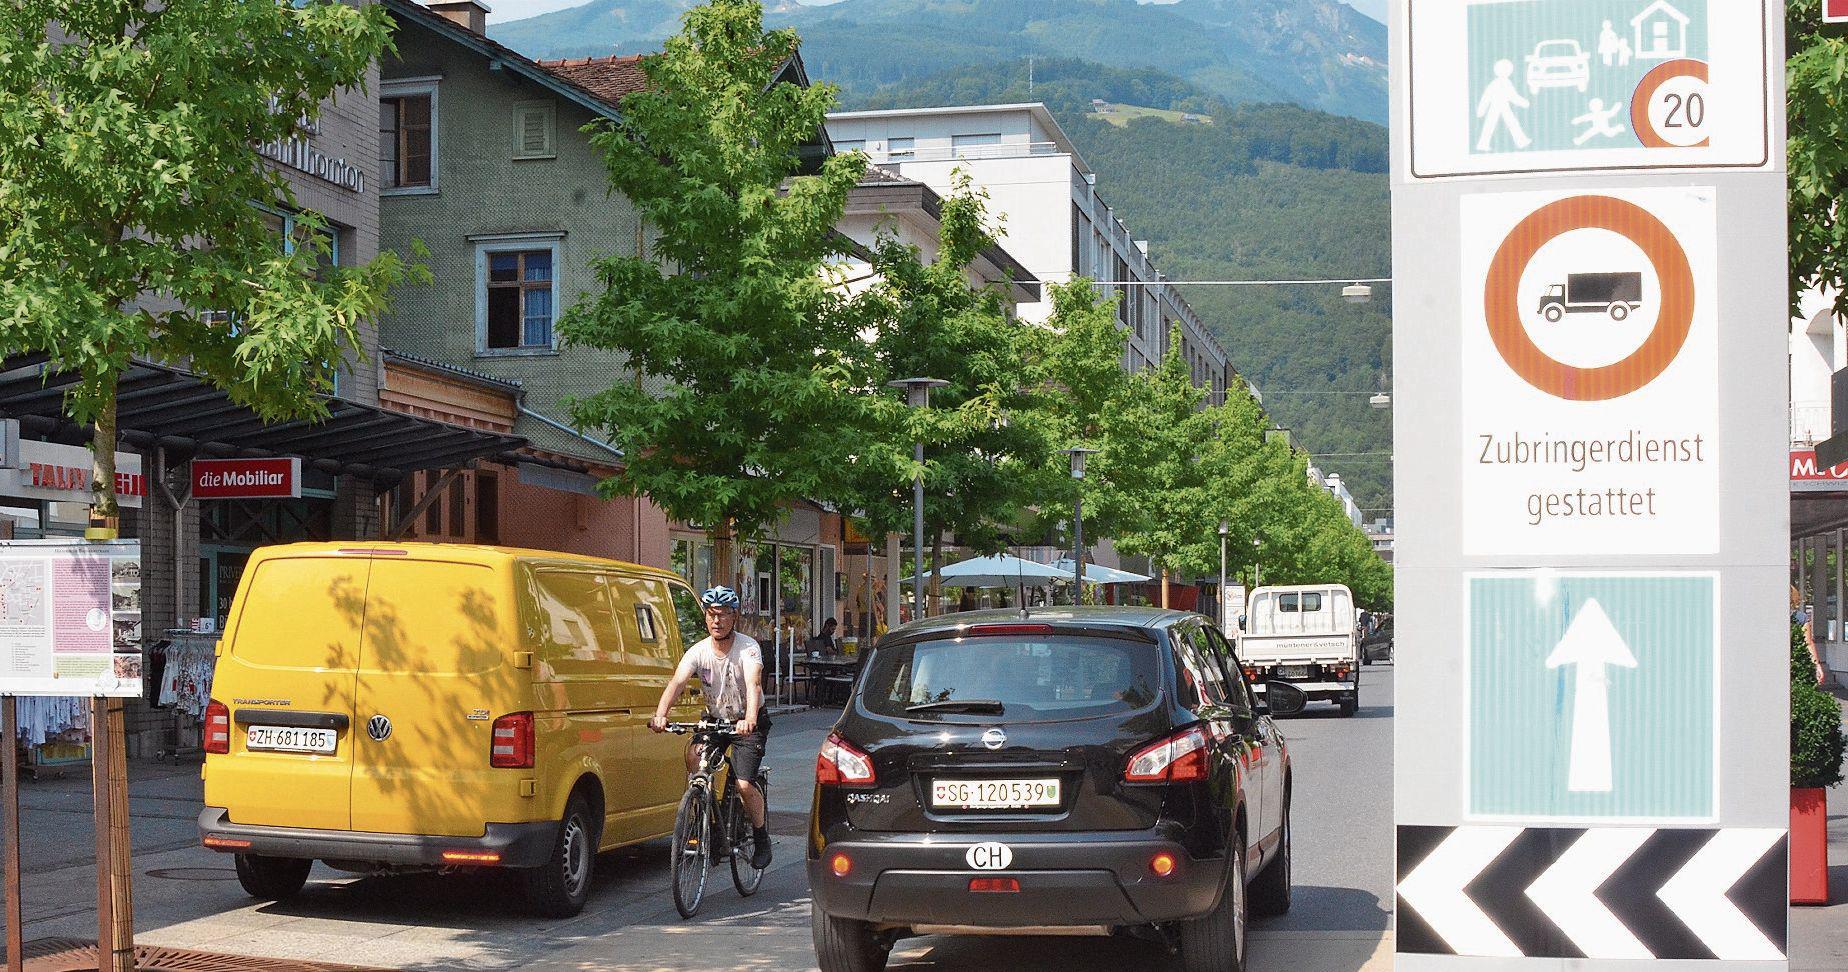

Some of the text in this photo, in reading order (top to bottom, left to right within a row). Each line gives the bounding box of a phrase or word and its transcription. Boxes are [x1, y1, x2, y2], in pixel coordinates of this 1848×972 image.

[1664, 92, 1705, 128] 20
[1479, 429, 1704, 473] Zubringerdienst
[200, 470, 284, 487] die Mobiliar
[1527, 487, 1656, 526] gestattet
[232, 698, 292, 706] TRANSPORTER
[973, 846, 1003, 867] CH
